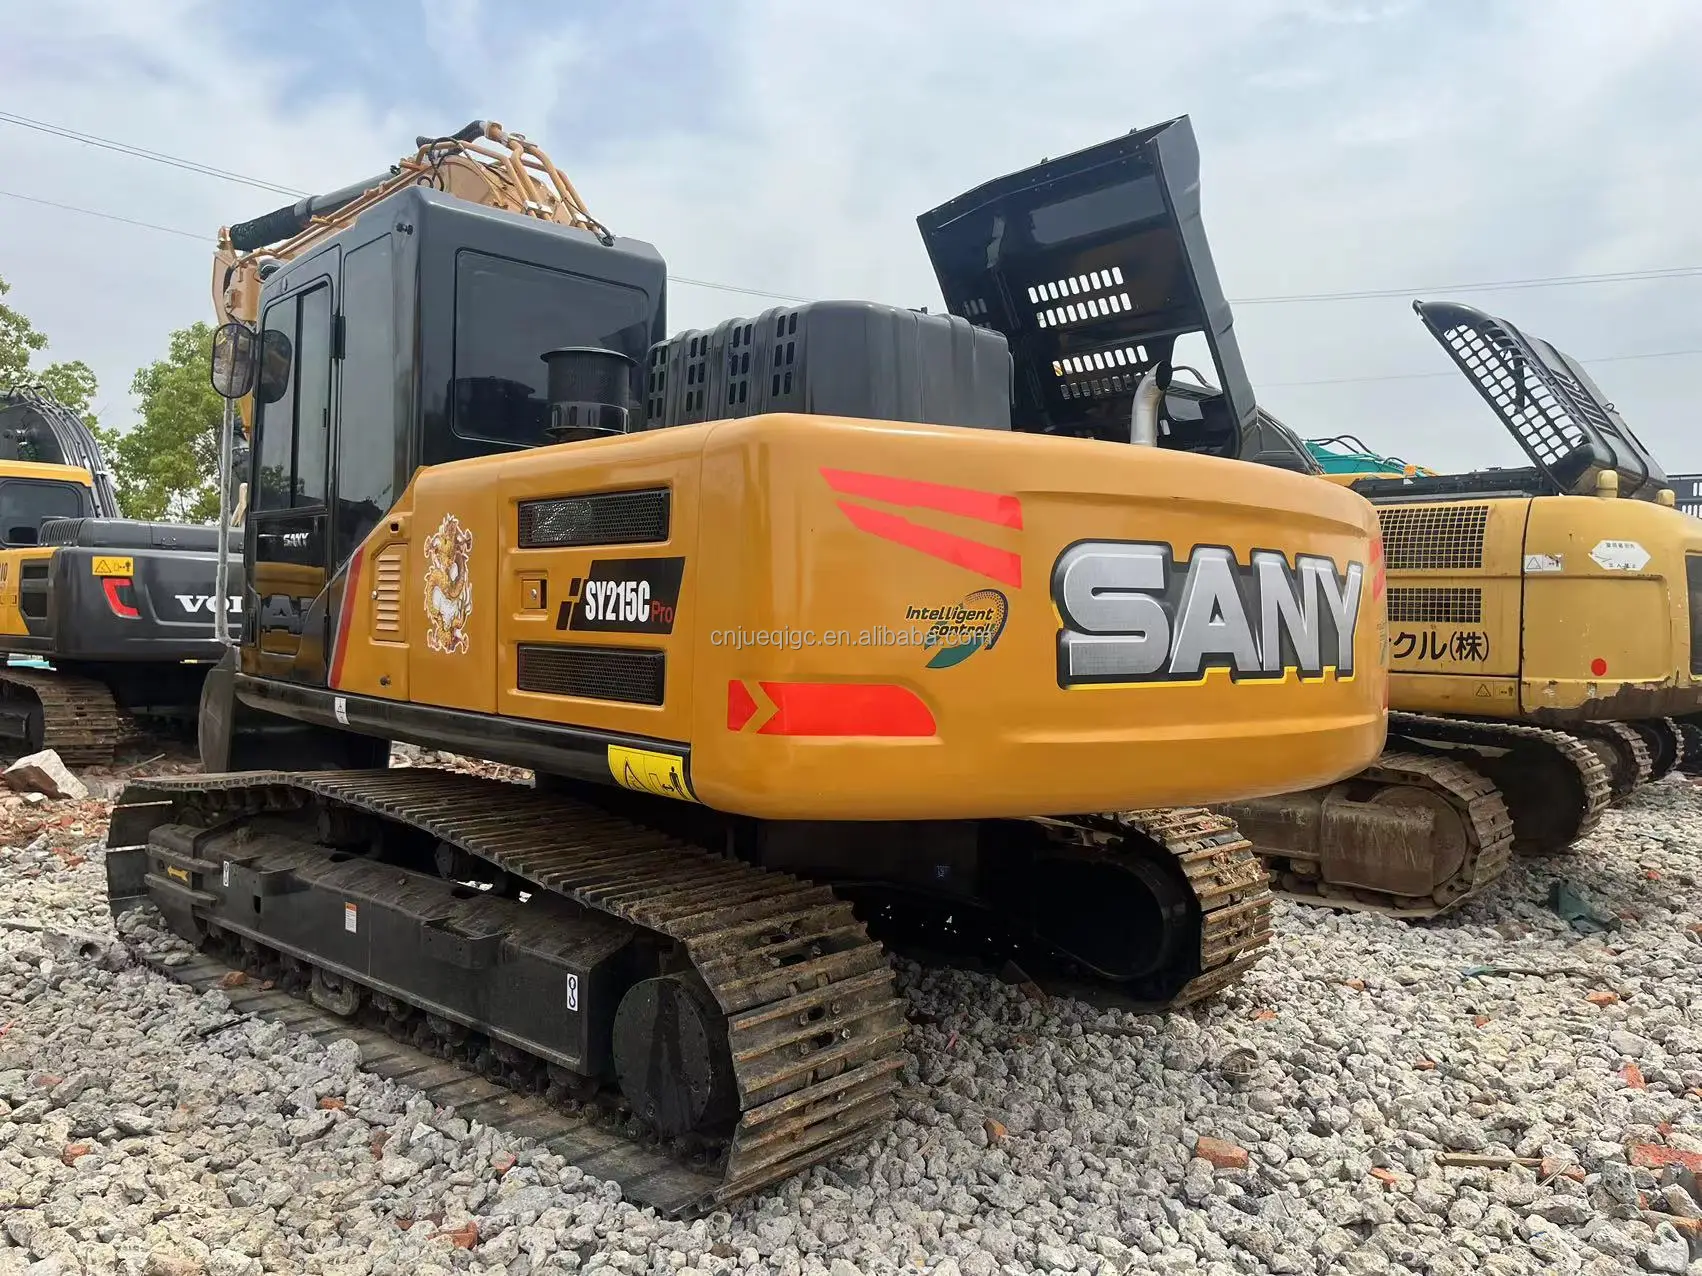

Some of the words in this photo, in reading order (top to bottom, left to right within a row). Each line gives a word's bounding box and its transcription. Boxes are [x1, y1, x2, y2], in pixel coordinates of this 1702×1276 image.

[585, 580, 651, 622] SY215C
[651, 600, 674, 624] Pro
[905, 605, 995, 624] Intelligent
[1052, 541, 1364, 683] SANY
[927, 622, 990, 637] control
[1389, 631, 1490, 661] クル(株)
